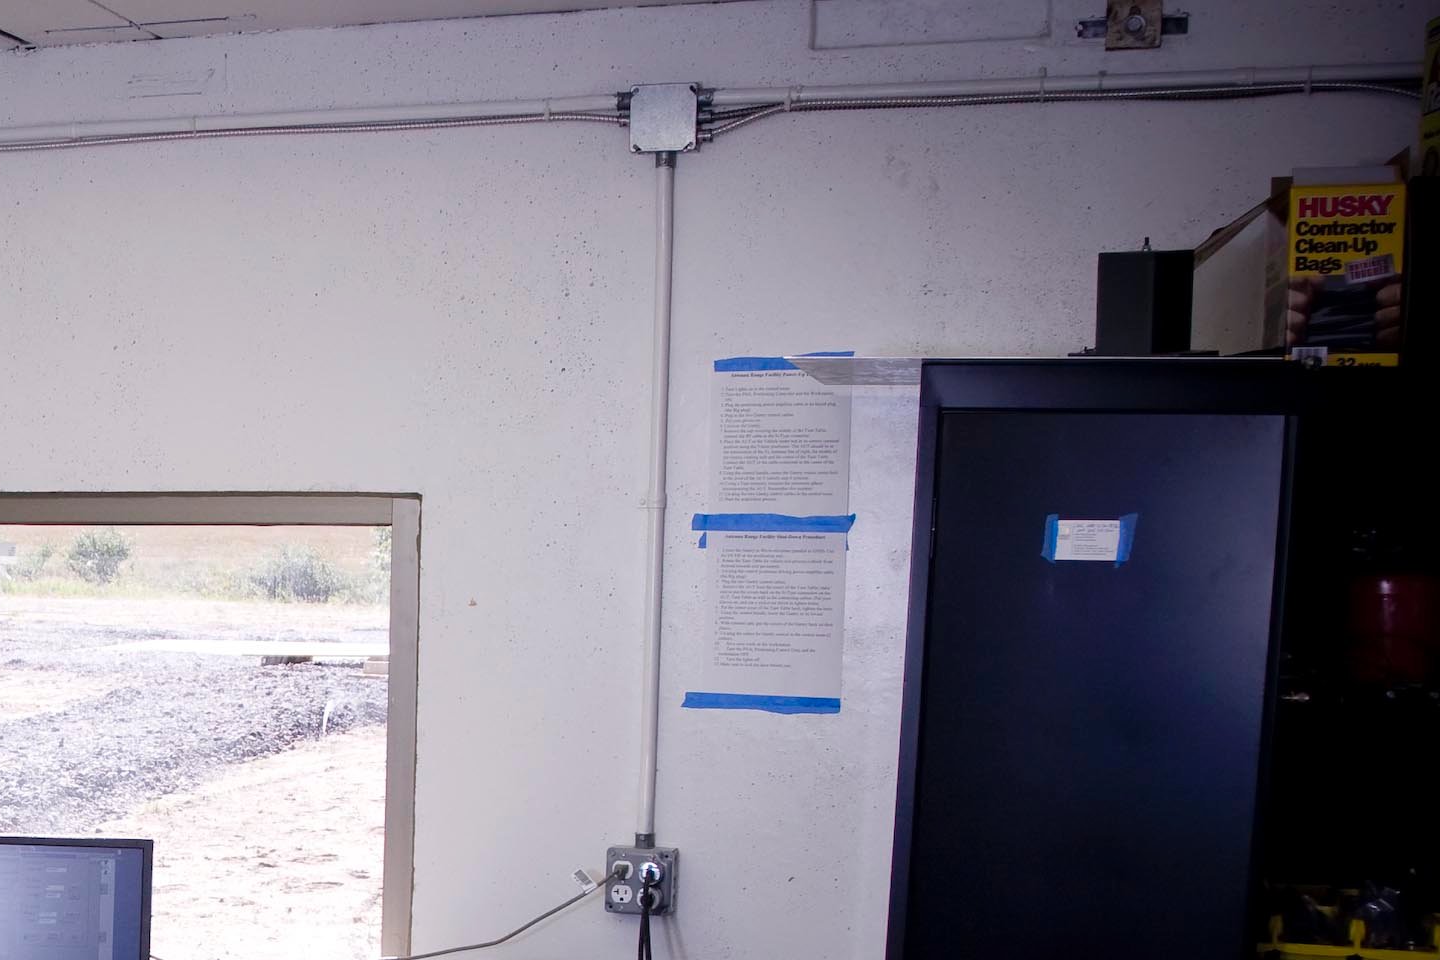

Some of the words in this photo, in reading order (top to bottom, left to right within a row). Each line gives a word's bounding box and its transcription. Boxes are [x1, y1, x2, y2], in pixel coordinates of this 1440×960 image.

[1298, 194, 1394, 218] HUSKY
[1295, 219, 1397, 236] Contractor
[1295, 237, 1378, 255] Clean-Up
[1295, 256, 1342, 274] Bags
